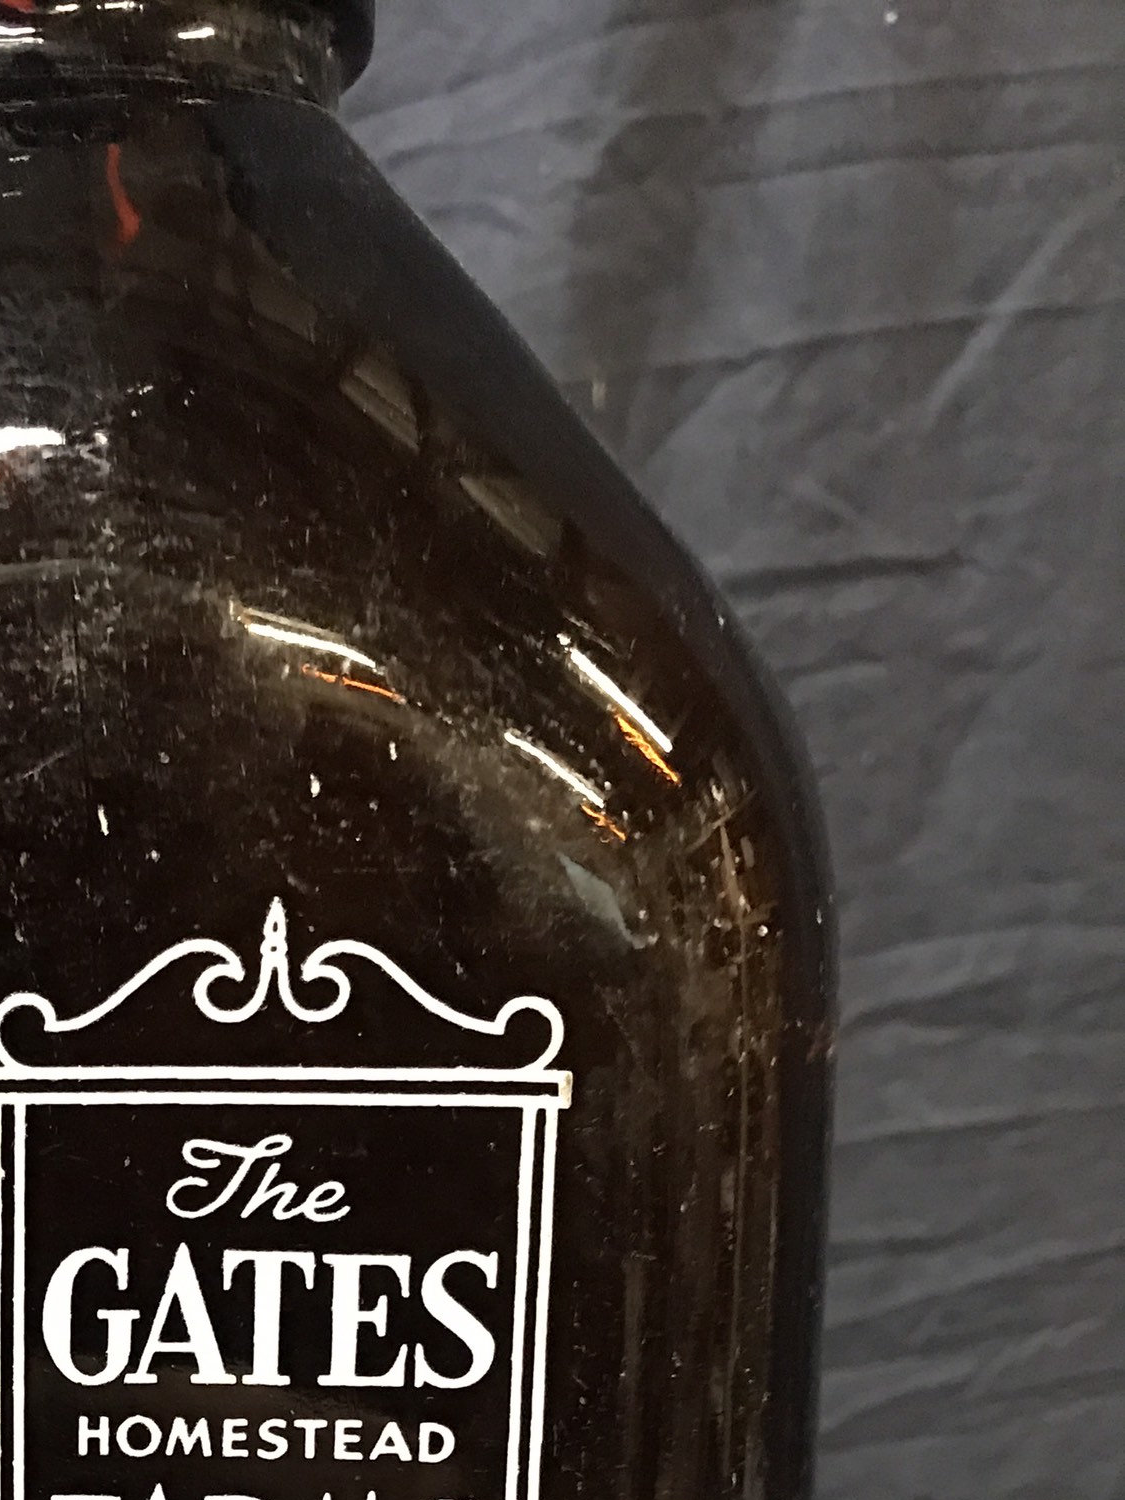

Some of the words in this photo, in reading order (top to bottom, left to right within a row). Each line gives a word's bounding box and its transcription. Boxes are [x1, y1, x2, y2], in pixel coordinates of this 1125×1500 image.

[166, 1133, 351, 1222] The
[41, 1243, 498, 1389] GATES
[78, 1415, 456, 1463] HOMESTEAD
